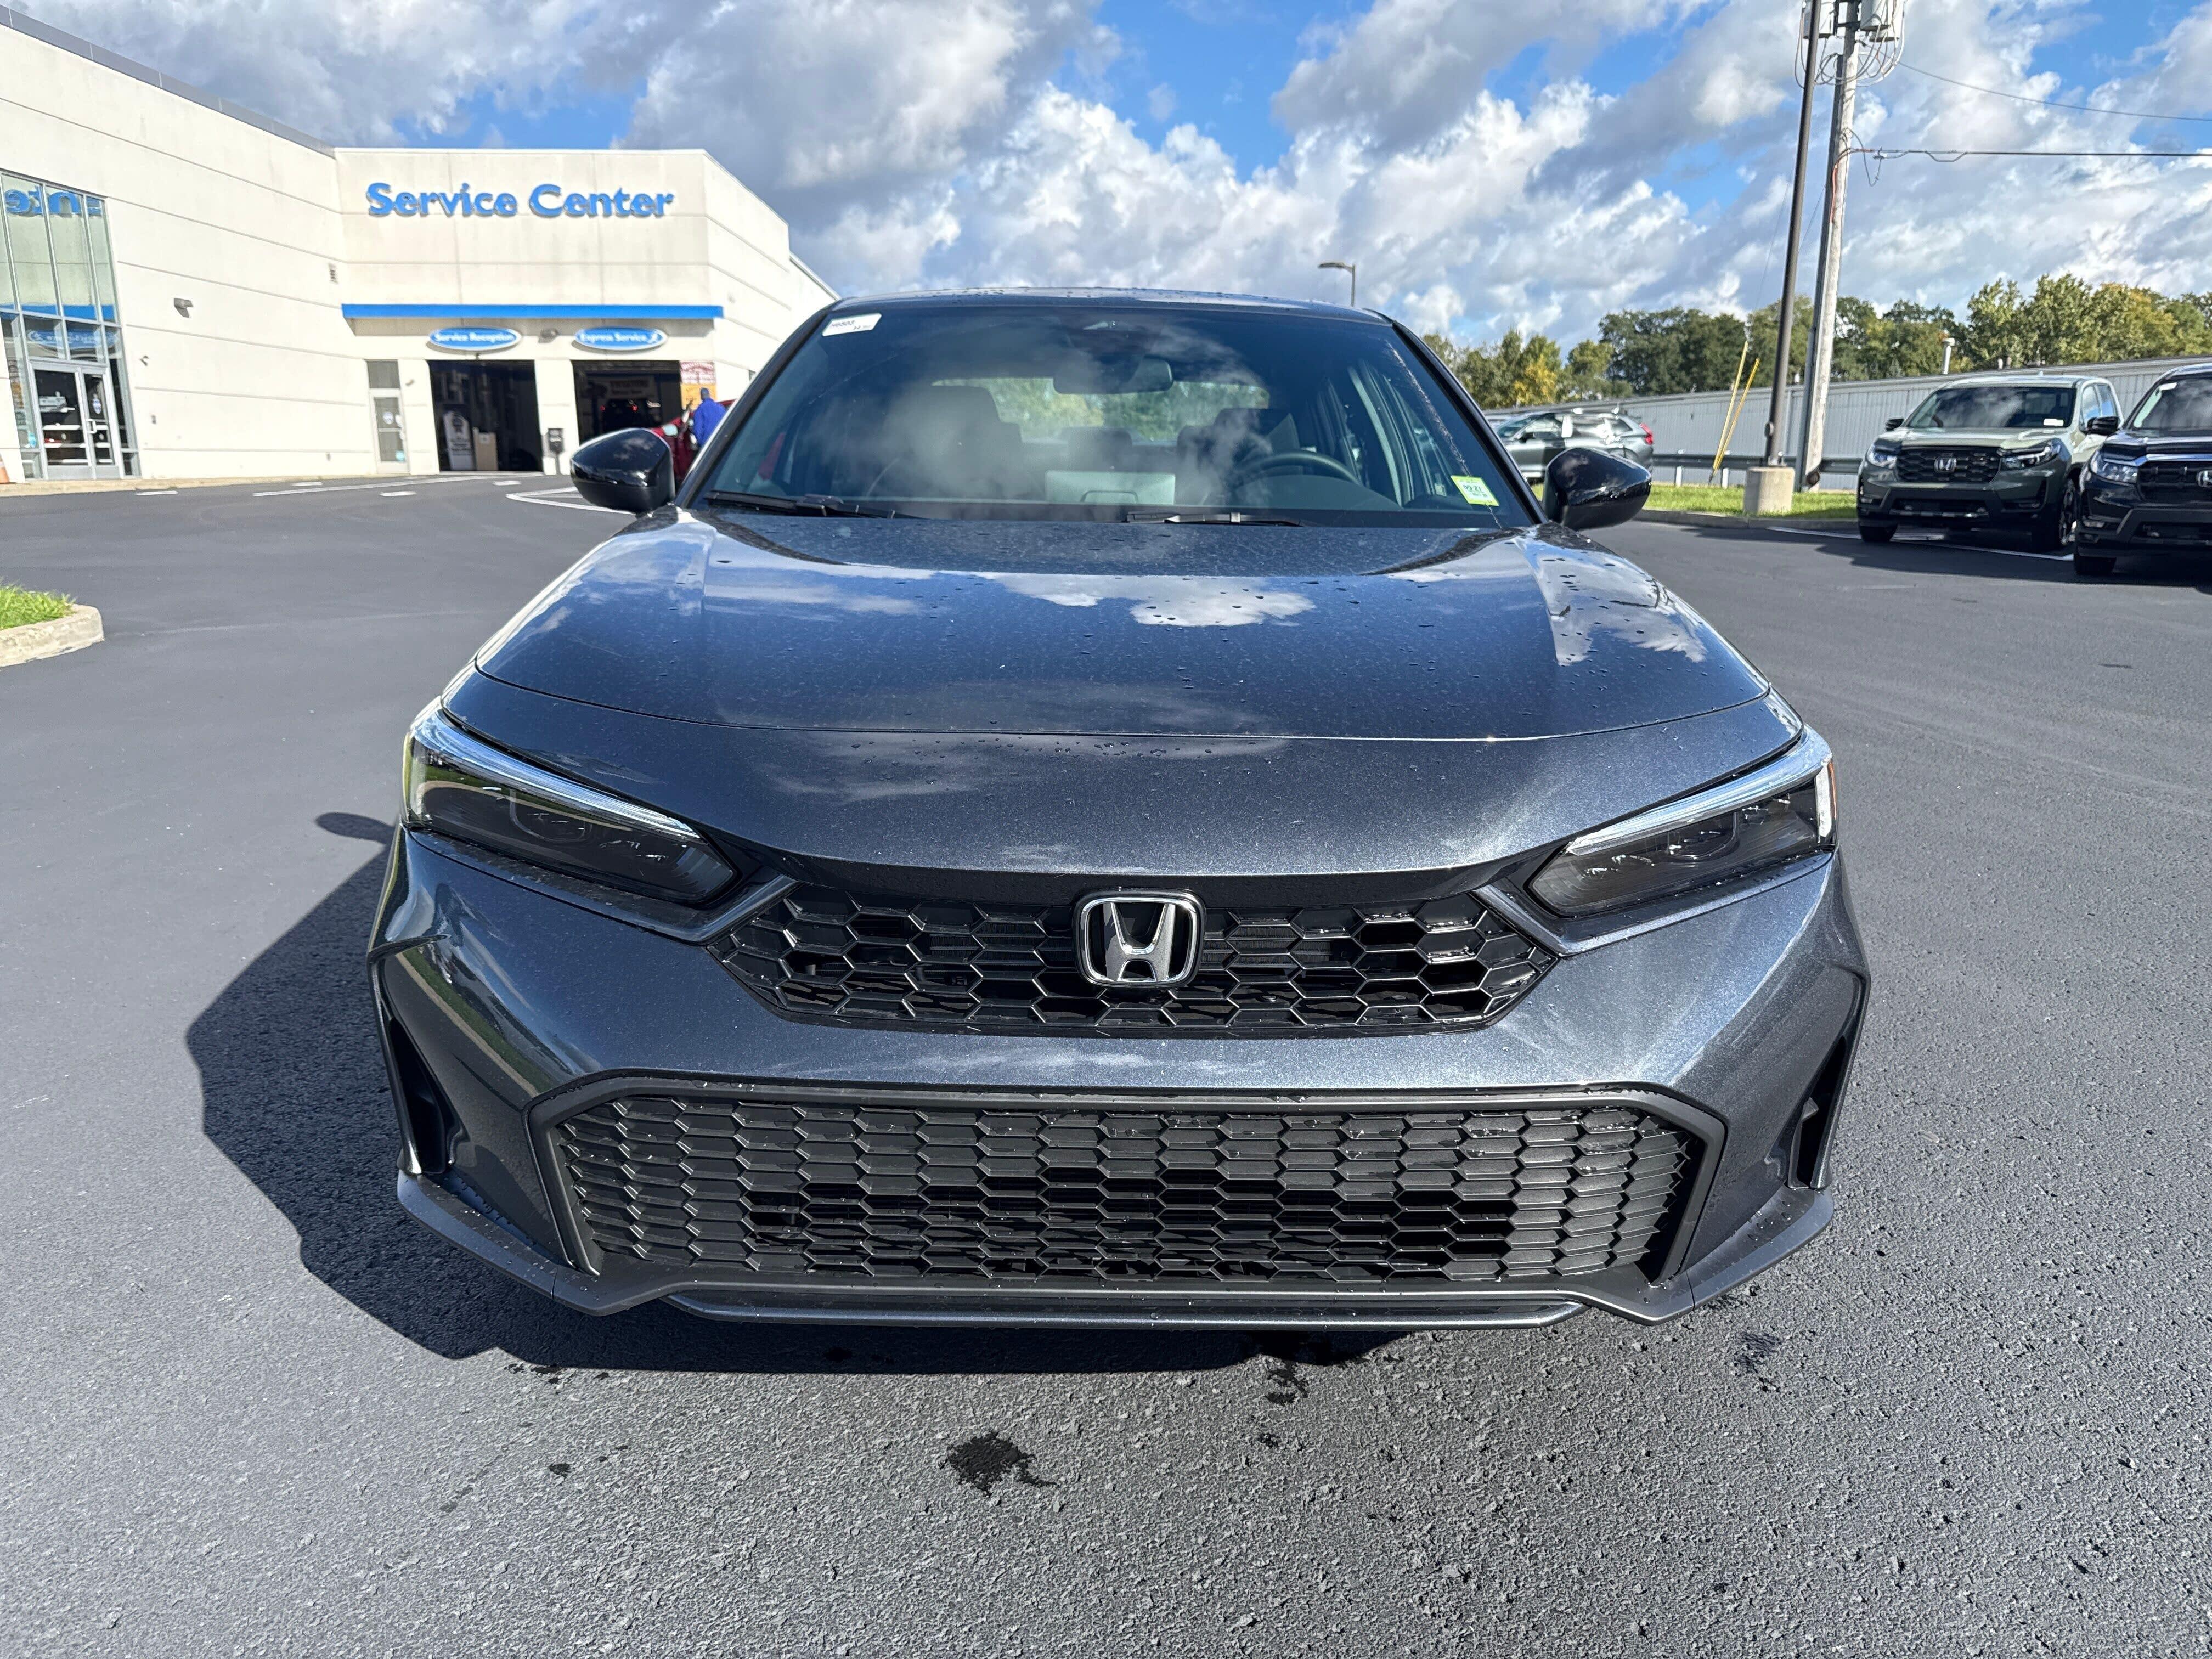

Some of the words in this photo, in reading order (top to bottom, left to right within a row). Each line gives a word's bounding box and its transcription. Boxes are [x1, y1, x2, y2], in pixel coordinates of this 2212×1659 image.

[366, 182, 518, 217] Service
[528, 184, 674, 218] Center
[434, 332, 469, 342] Service
[470, 332, 516, 343] Reception
[579, 332, 614, 343] Express
[614, 332, 647, 342] Service
